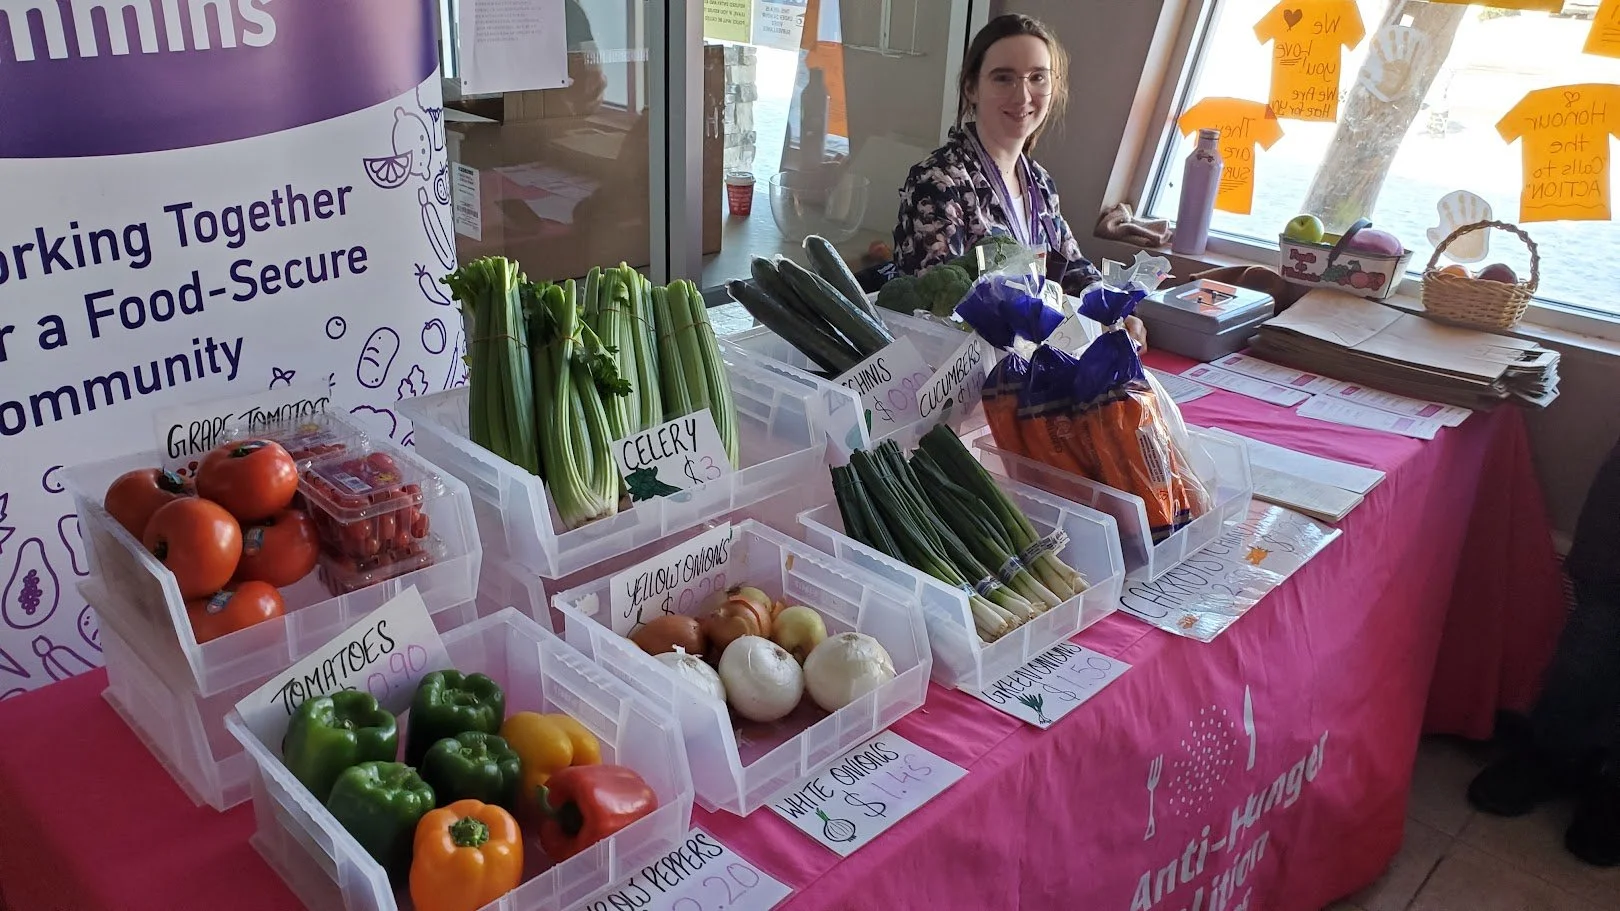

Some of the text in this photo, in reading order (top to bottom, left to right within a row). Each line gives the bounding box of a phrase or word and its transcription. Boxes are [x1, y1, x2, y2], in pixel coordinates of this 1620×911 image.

[164, 184, 353, 249] Together
[37, 314, 69, 351] a
[84, 244, 369, 339] Food-Secure
[919, 339, 981, 418] CUCUMBERS
[622, 418, 698, 471] CELERY
[684, 455, 721, 485] $3
[624, 537, 731, 618] YELLOW ONIONS
[270, 619, 396, 716] TOMATOES
[981, 666, 1043, 704] GREEN
[775, 741, 900, 819] WHITE ONIONS
[1129, 729, 1329, 911] Anti-Hunger
[641, 832, 724, 893] PEPPERS
[1180, 830, 1270, 911] lition
